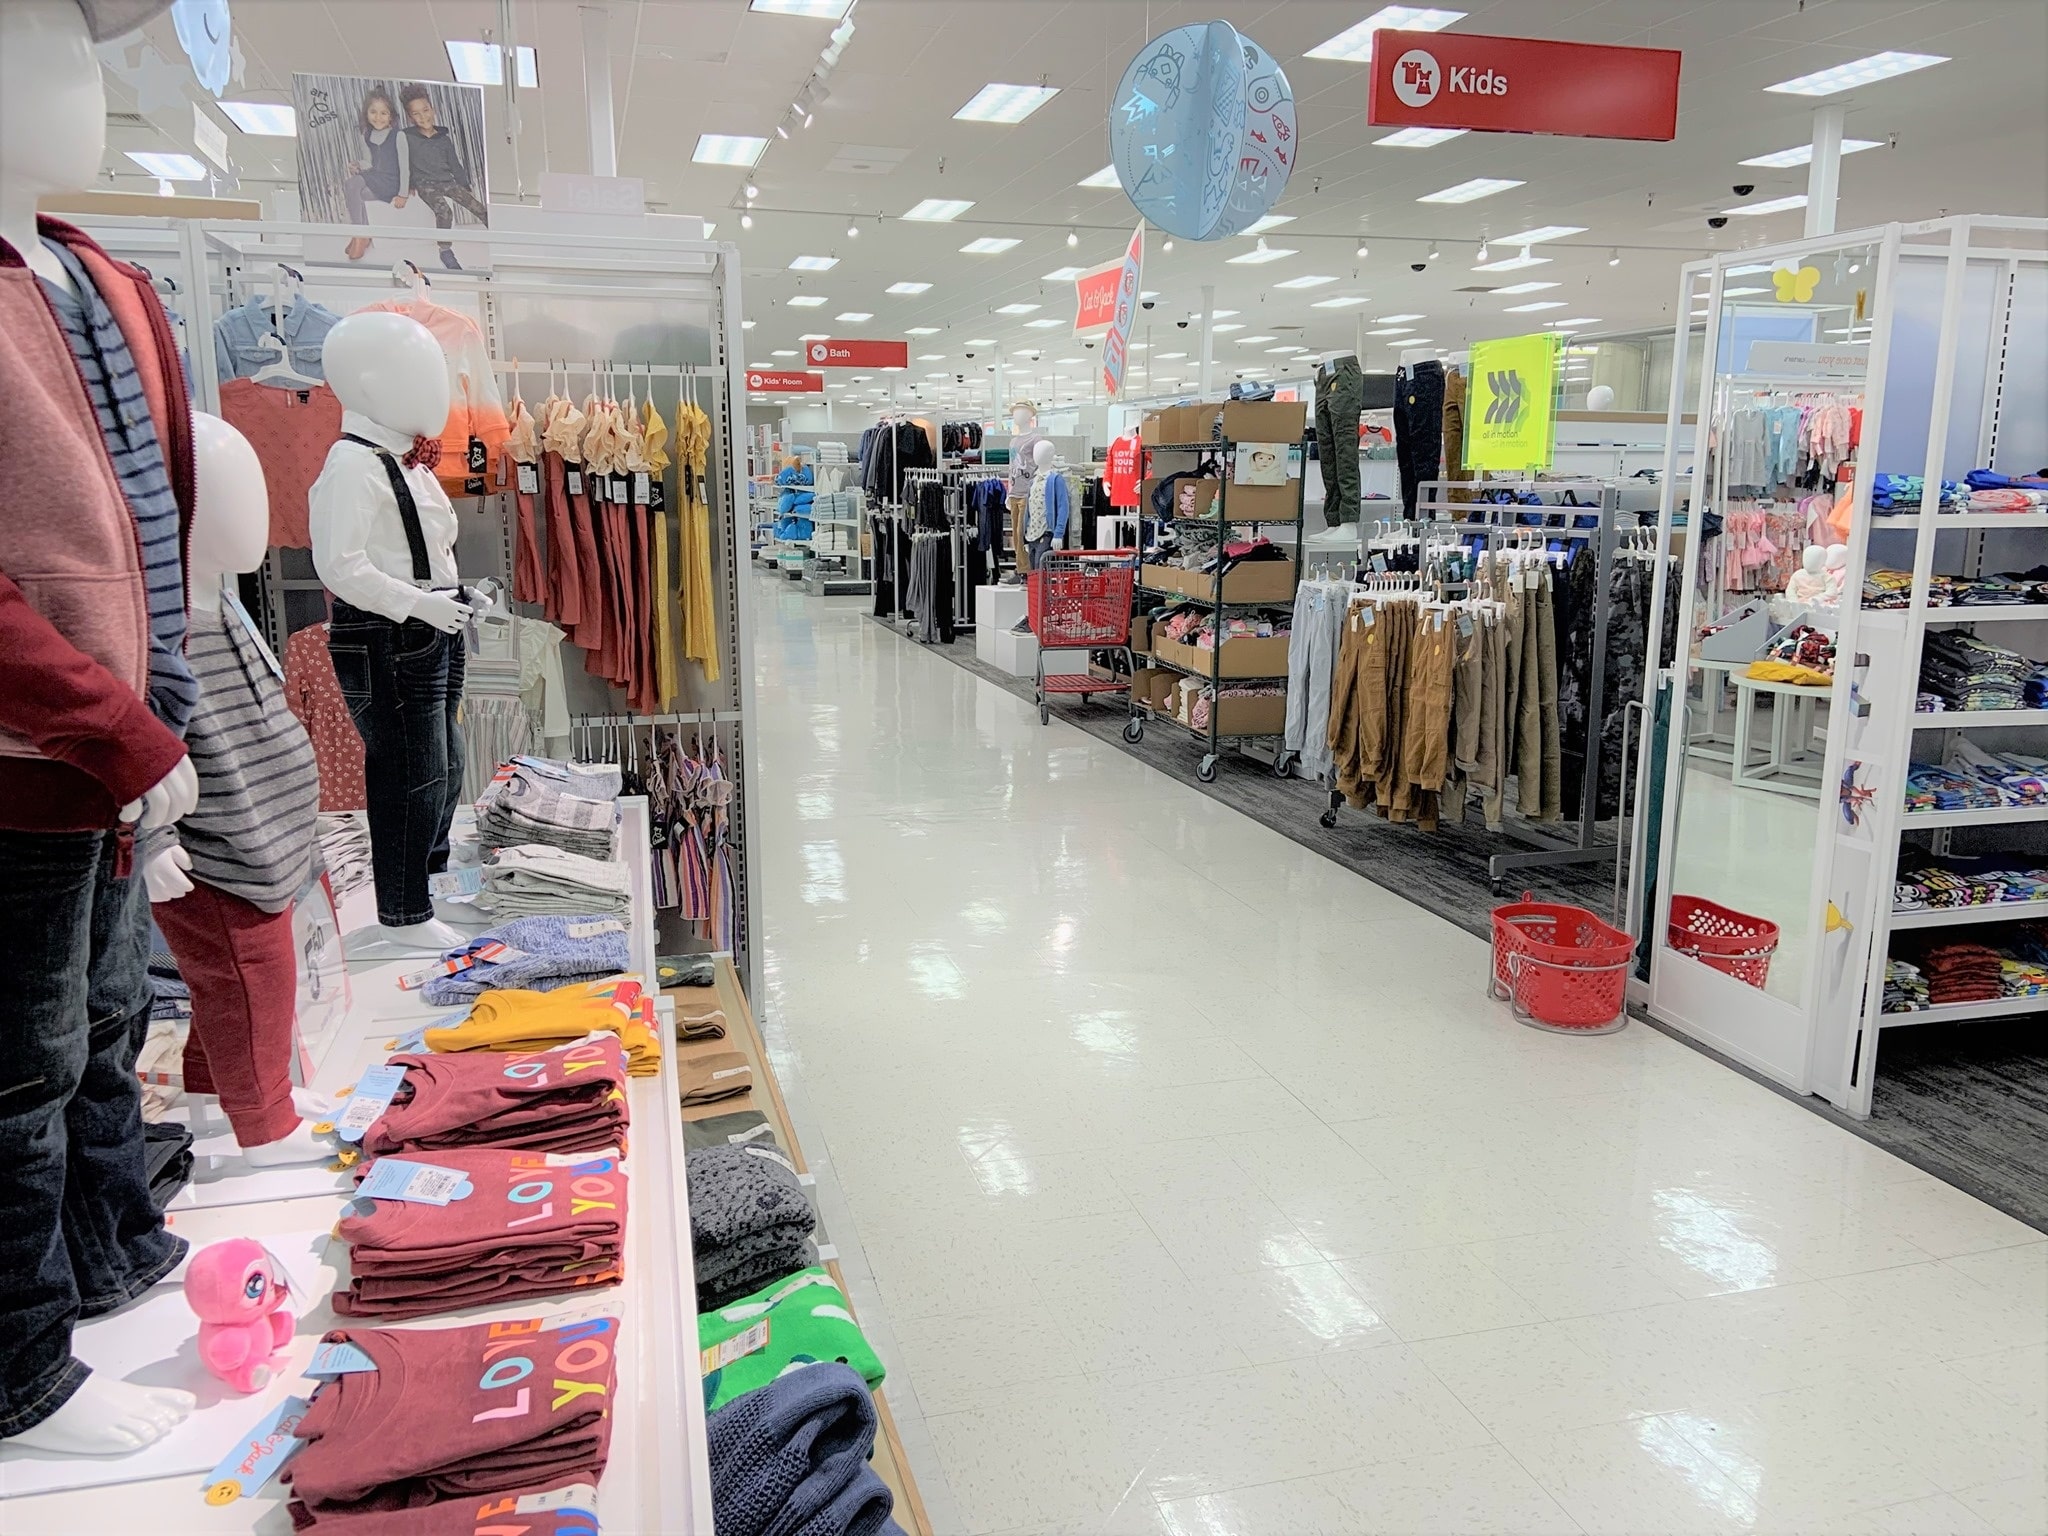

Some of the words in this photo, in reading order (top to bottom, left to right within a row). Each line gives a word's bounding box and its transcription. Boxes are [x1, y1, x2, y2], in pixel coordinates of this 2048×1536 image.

[1449, 66, 1508, 96] Kids
[310, 88, 328, 101] art
[309, 111, 338, 128] class
[829, 348, 850, 358] Bath
[782, 378, 803, 386] Room
[1482, 430, 1491, 440] all
[1497, 430, 1519, 439] motion
[1114, 450, 1135, 458] LOVE
[1114, 466, 1134, 474] SELF
[507, 1156, 554, 1229] LOVE
[569, 1158, 617, 1217] YOU
[472, 1317, 543, 1424] LOVE
[551, 1318, 613, 1413] YOU
[233, 1440, 274, 1477] Jack
